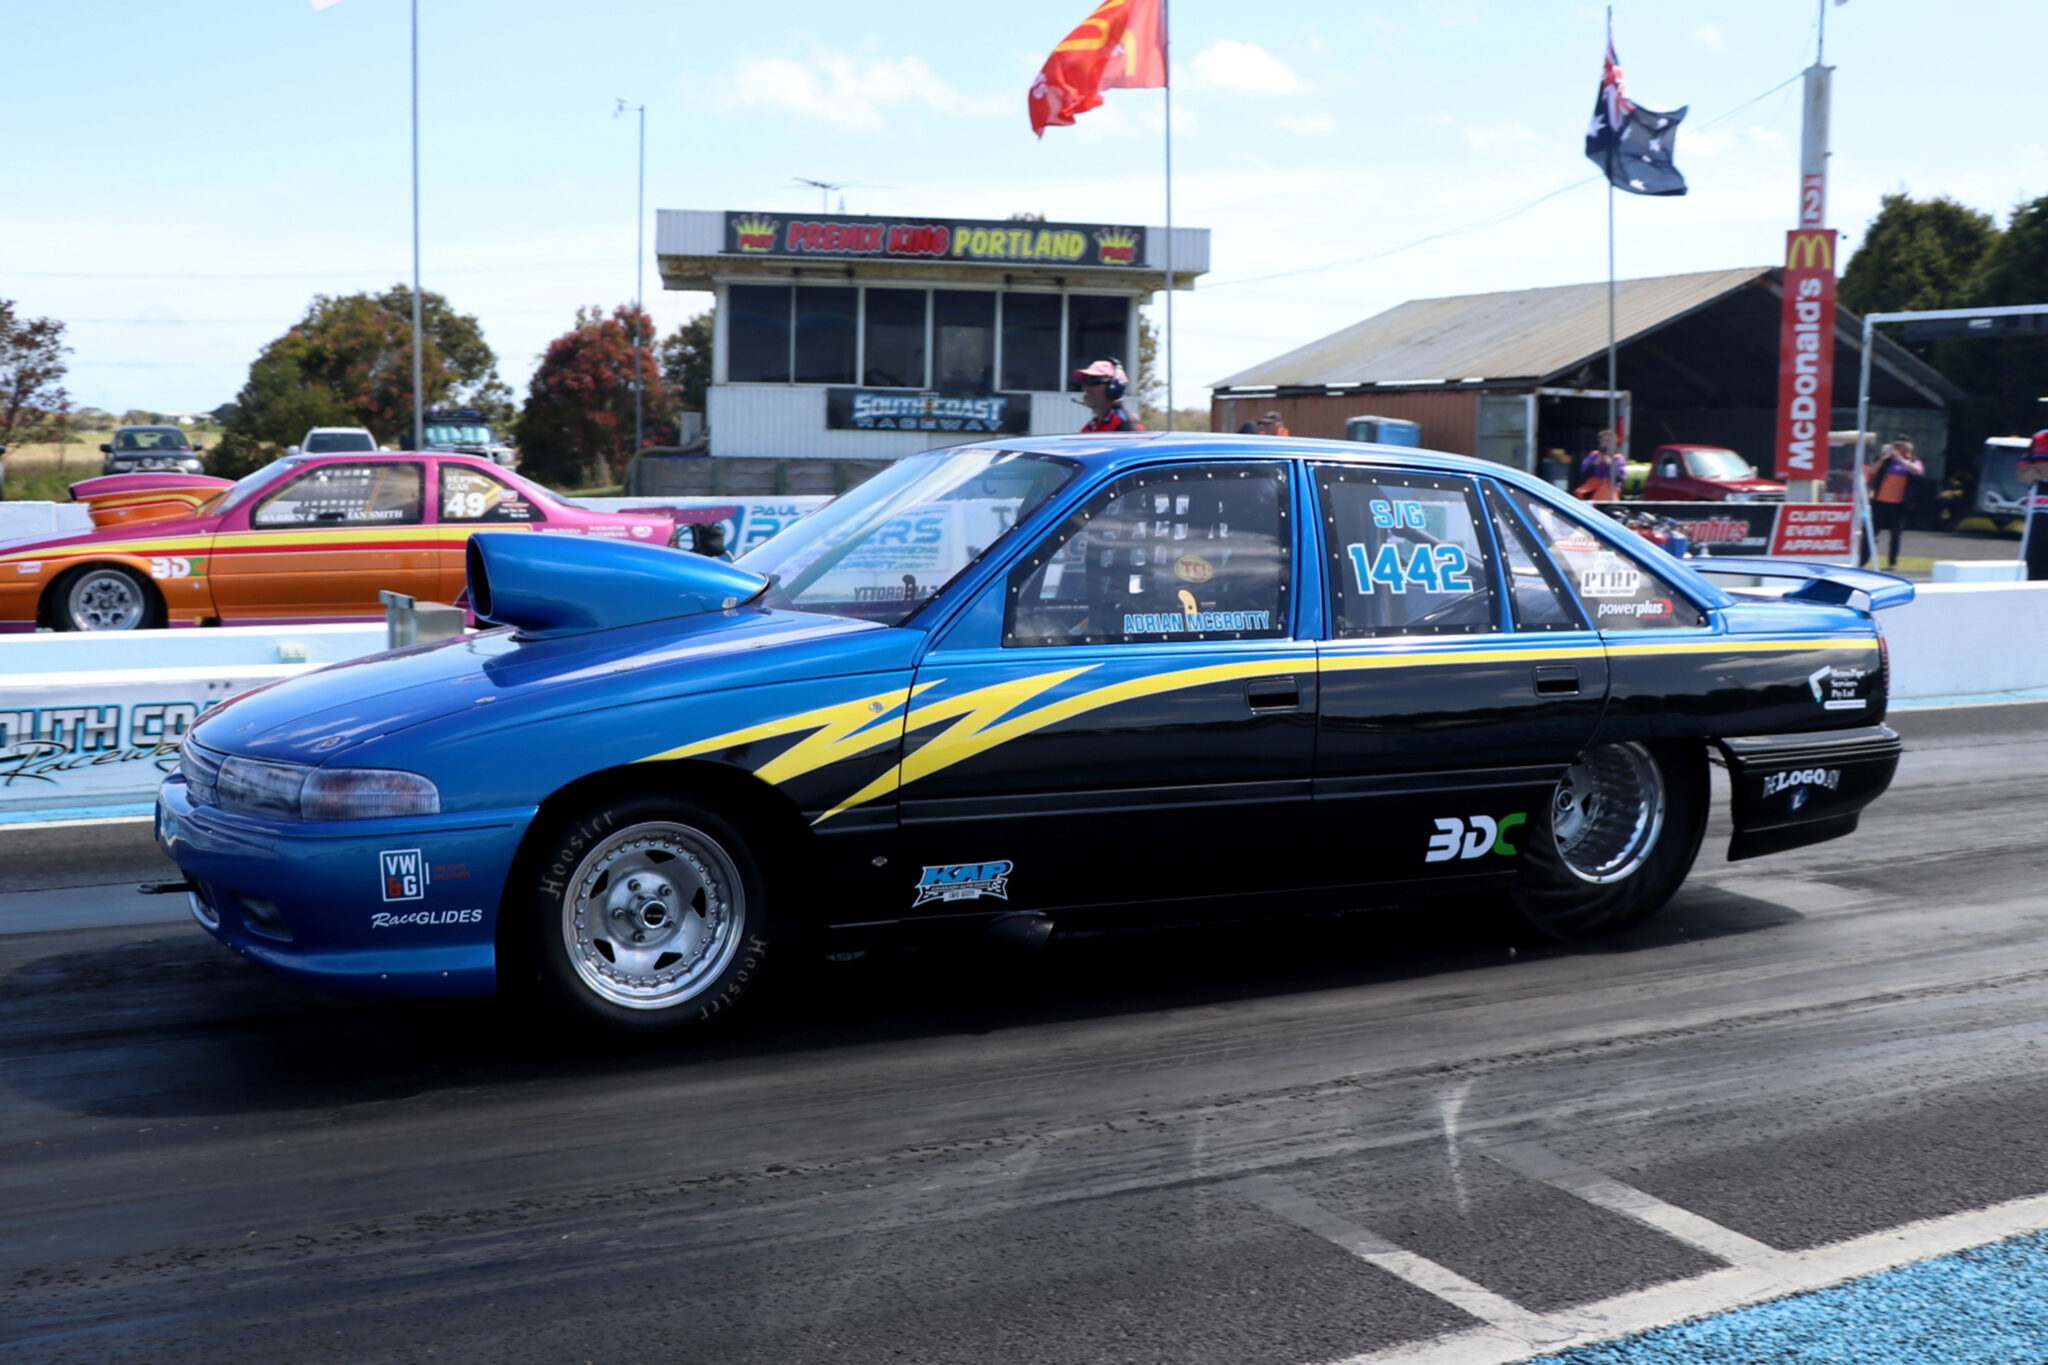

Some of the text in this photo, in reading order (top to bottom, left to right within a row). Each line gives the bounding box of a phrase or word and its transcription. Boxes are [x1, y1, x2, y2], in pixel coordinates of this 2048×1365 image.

[787, 221, 885, 252] PREMIX
[887, 224, 949, 255] KING
[953, 228, 1087, 260] PORTLAND
[1788, 278, 1822, 471] McDonald's
[854, 393, 1008, 420] SOUTH COAST
[857, 417, 1003, 431] RACEWAY
[369, 510, 404, 519] SMITH
[446, 492, 486, 518] 49
[751, 505, 798, 516] PAUL
[1369, 500, 1426, 528] S/G
[1789, 511, 1851, 523] CUSTOM
[1785, 525, 1835, 537] EVENT
[1782, 539, 1849, 551] APPAREL
[1347, 543, 1474, 595] 1442
[1598, 599, 1664, 618] powerplus
[1124, 611, 1269, 633] ADRIAN MCGROTTY
[1775, 768, 1826, 791] LOGO
[385, 854, 416, 876] VW
[539, 808, 615, 900] Hoosier
[920, 862, 1008, 886] KAP
